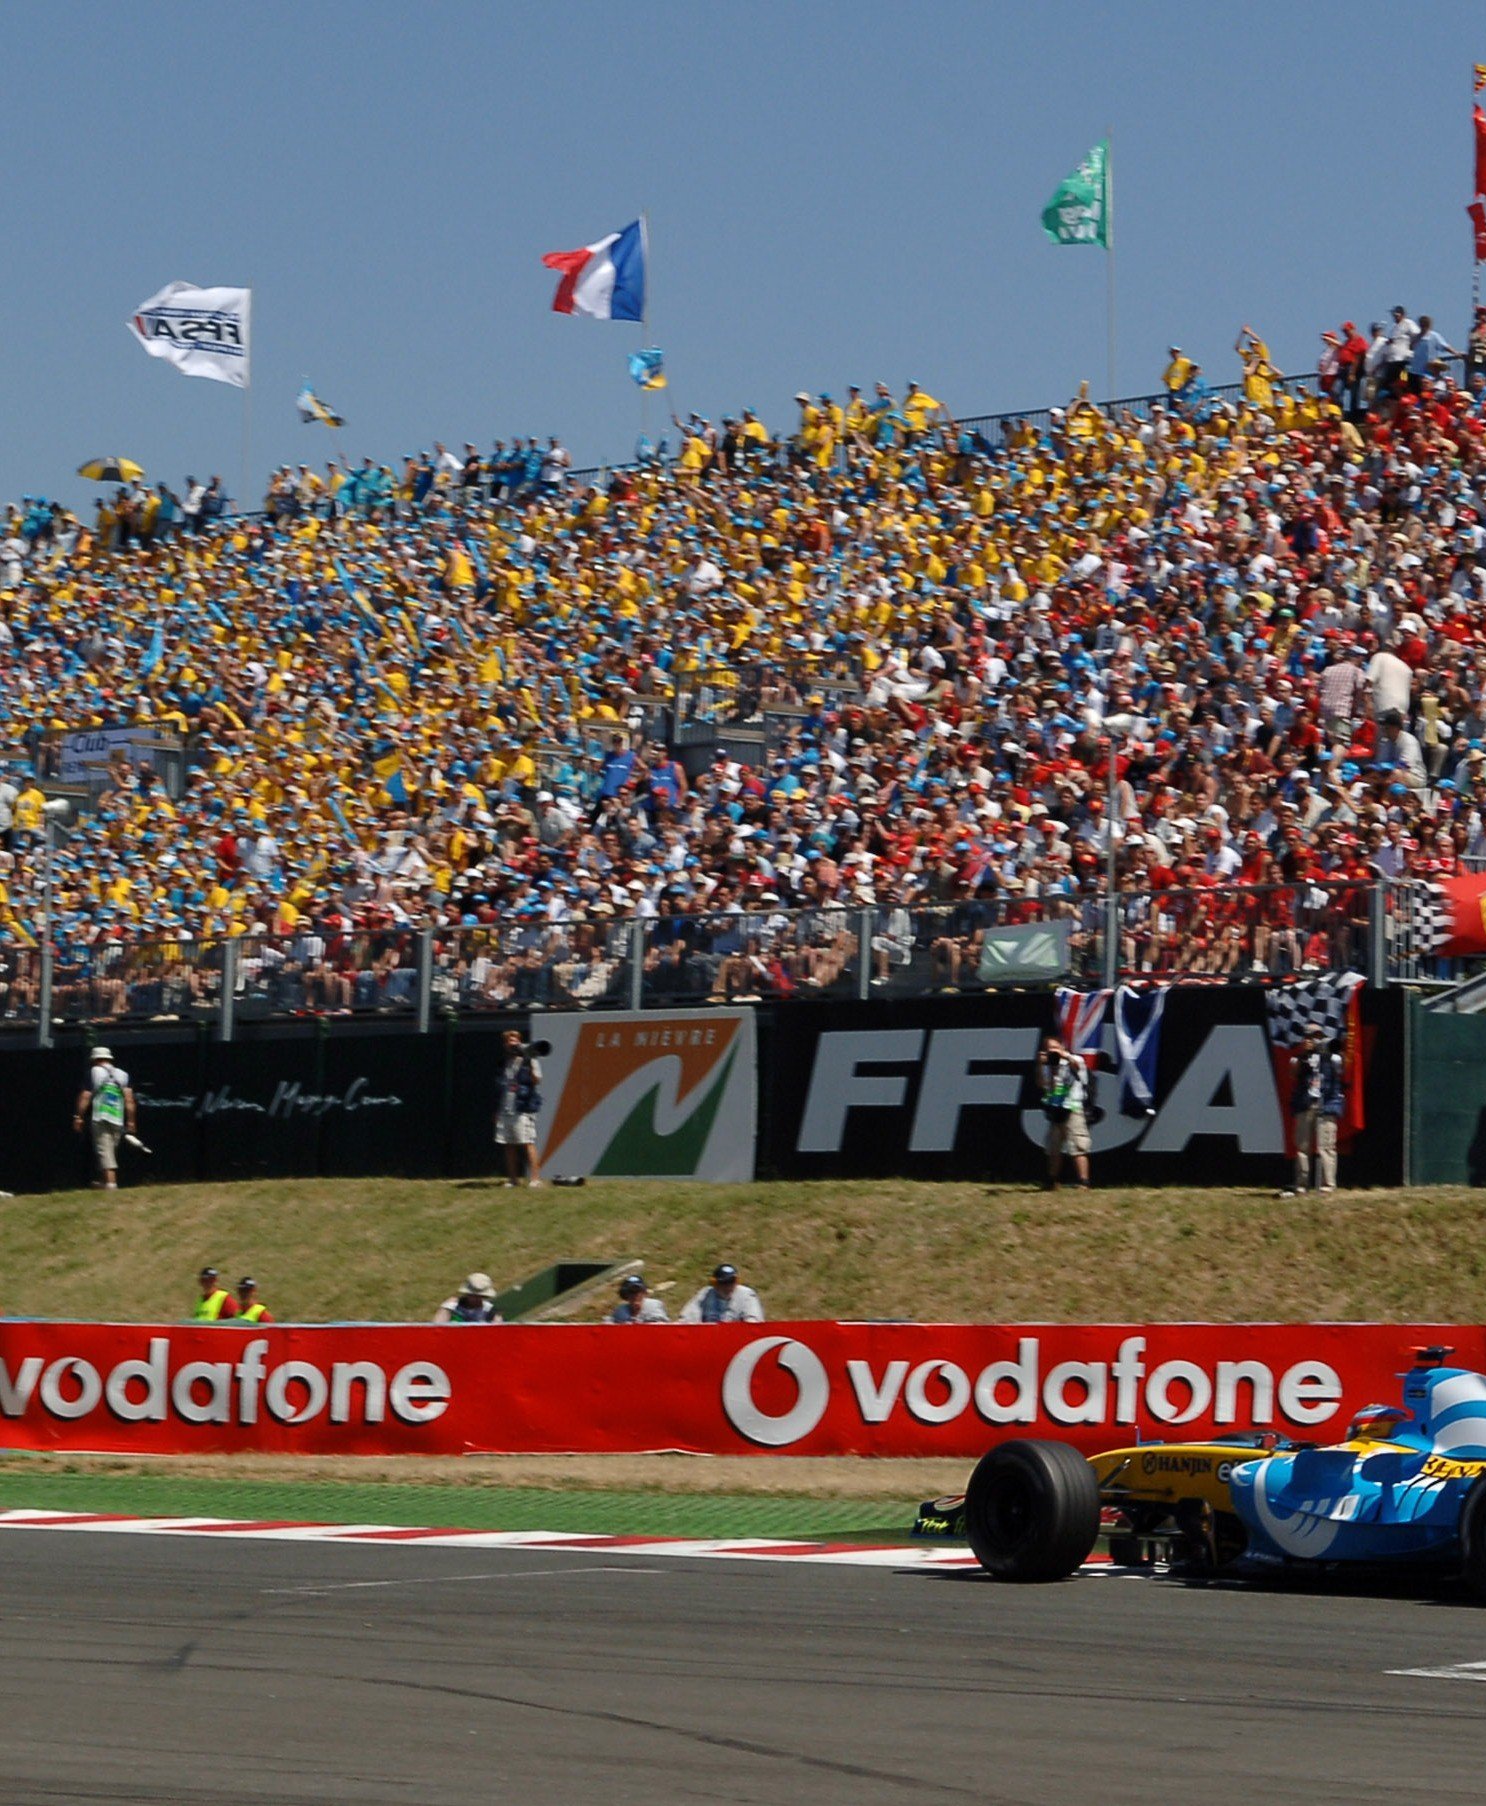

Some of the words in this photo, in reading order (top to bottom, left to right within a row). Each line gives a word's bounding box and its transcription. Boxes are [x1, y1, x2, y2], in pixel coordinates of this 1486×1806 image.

[0, 1337, 452, 1424] vodafone
[847, 1336, 1343, 1424] vodafone
[1158, 1456, 1213, 1477] HANJIN
